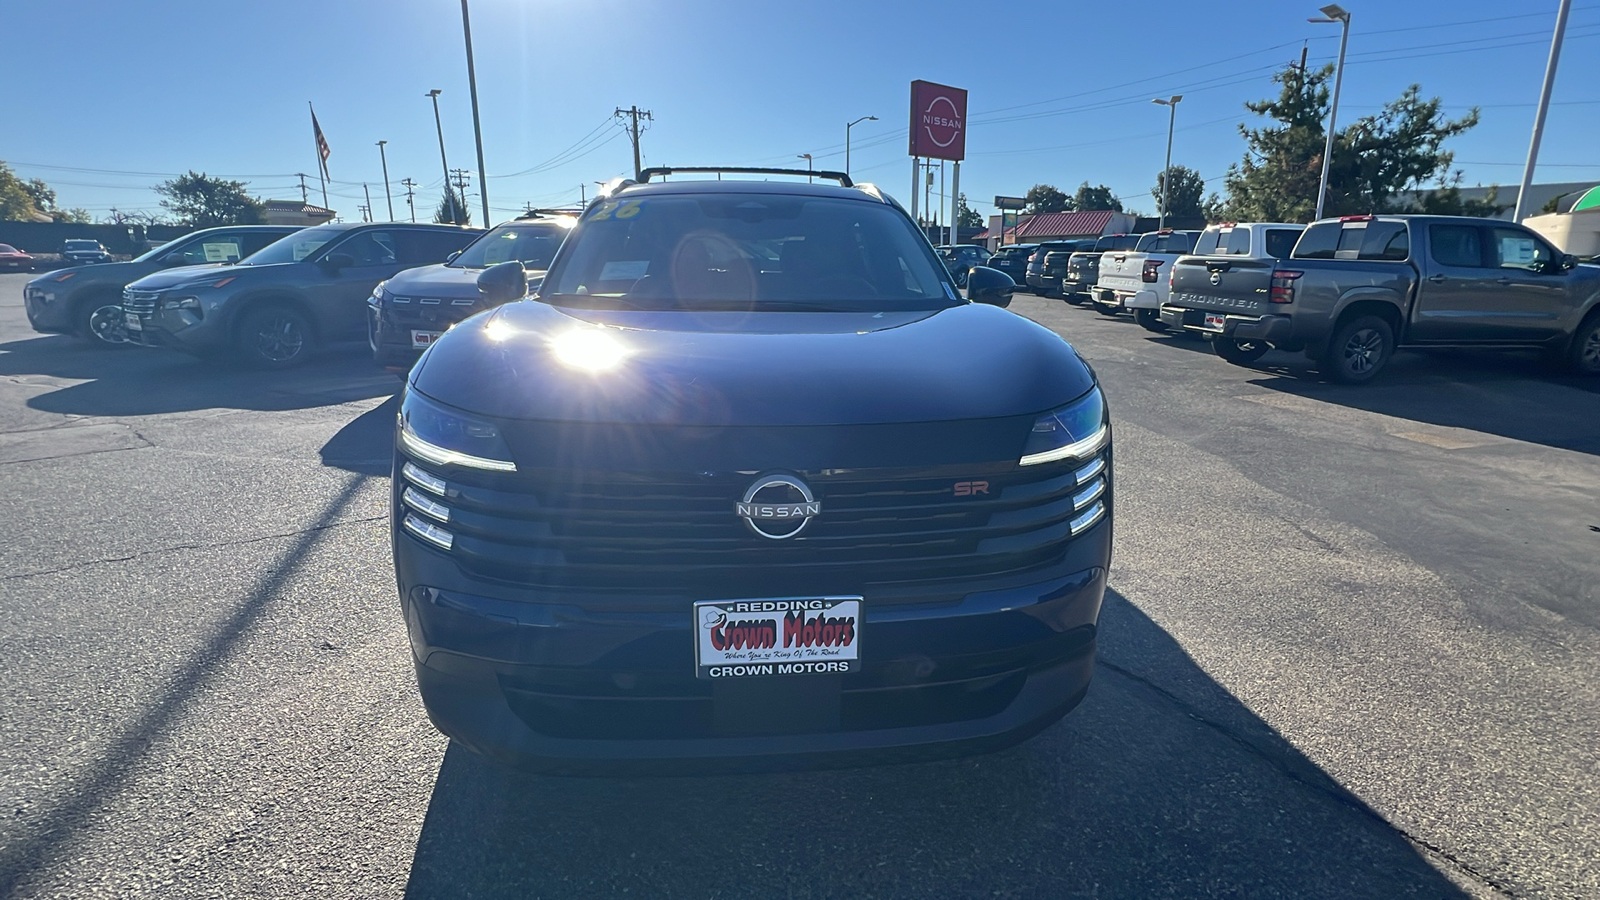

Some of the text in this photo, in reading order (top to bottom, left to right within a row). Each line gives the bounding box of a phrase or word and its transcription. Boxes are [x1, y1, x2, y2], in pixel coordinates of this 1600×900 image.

[923, 115, 962, 129] NISSAN
[588, 199, 644, 222] 26
[1179, 293, 1259, 309] FRONTIER
[953, 480, 990, 497] SR
[738, 503, 819, 517] NISSAN
[736, 600, 823, 612] REDDING
[710, 610, 855, 651] Crown Motors
[724, 648, 841, 661] Where You're King Of The Road
[709, 661, 849, 678] CROWN MOTORS
